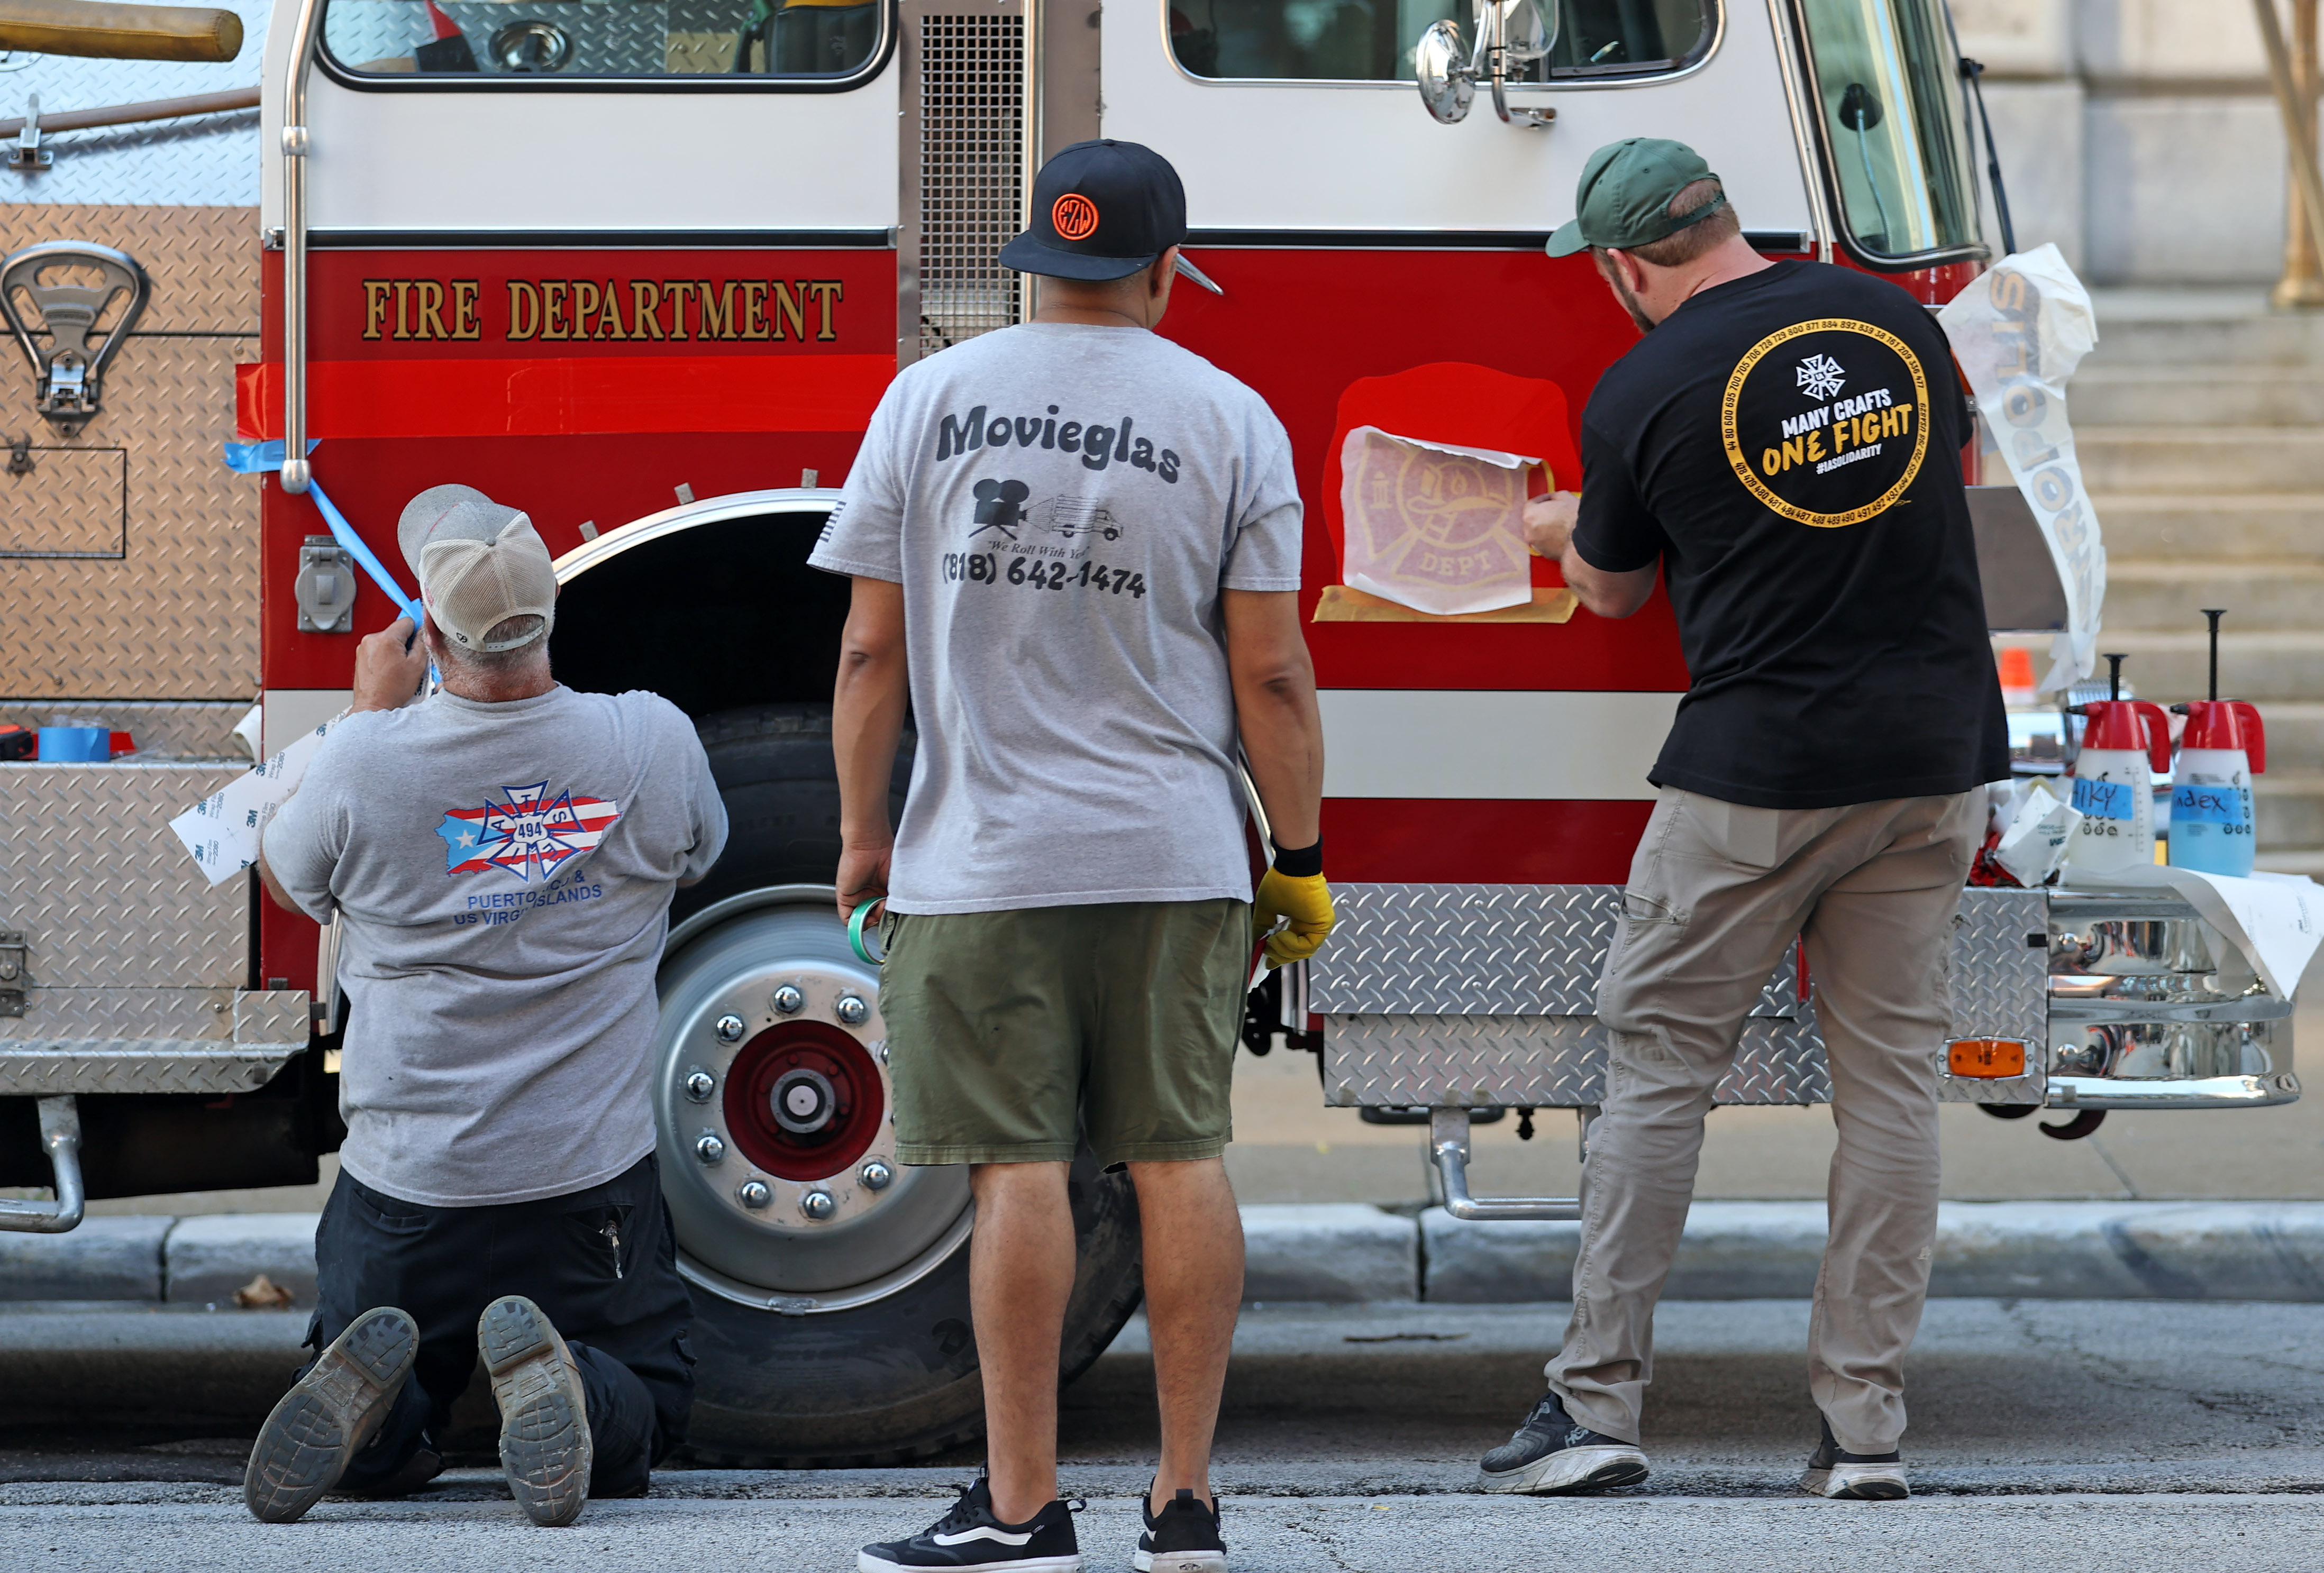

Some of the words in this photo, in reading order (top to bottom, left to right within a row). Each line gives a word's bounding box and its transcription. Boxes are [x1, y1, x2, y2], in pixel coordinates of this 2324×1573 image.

[362, 279, 480, 341] FIRE
[506, 279, 843, 343] DEPARTMENT
[1788, 325, 1803, 335] 800
[1806, 322, 1819, 330] 871
[1840, 321, 1856, 330] 892
[1858, 324, 1874, 334] 839
[1772, 332, 1787, 343] 729
[1875, 330, 1886, 339] 38
[1886, 336, 1900, 347] 161
[1758, 339, 1772, 351] 728
[1747, 349, 1761, 362] 706
[1898, 346, 1912, 360] 209
[1737, 361, 1749, 375] 705
[1909, 361, 1920, 373] 336
[1730, 376, 1741, 390] 700
[1726, 392, 1736, 407] 695
[1724, 410, 1734, 426] 600
[1781, 406, 1830, 438] MANY
[1833, 388, 1892, 420] CRAFTS
[1725, 428, 1734, 438] 80
[1762, 431, 1827, 476] ONE
[1832, 403, 1913, 454] FIGHT
[936, 405, 1181, 484] Movieglas
[1727, 441, 1736, 451] 44
[1816, 443, 1883, 475] #IASOLIDARITY
[1754, 486, 1770, 500] 480
[1768, 497, 1782, 509] 481
[1011, 543, 1034, 555] Roll
[1038, 546, 1065, 558] With
[1419, 550, 1492, 577] DEPT
[943, 552, 997, 585] (818)
[1007, 556, 1145, 599] 642-1474
[247, 809, 258, 828] 3M
[518, 821, 542, 838] 494
[195, 844, 205, 862] 3M
[468, 891, 536, 910] PUERTO
[574, 870, 585, 883] &
[453, 913, 477, 926] US
[533, 884, 602, 909] ISLANDS
